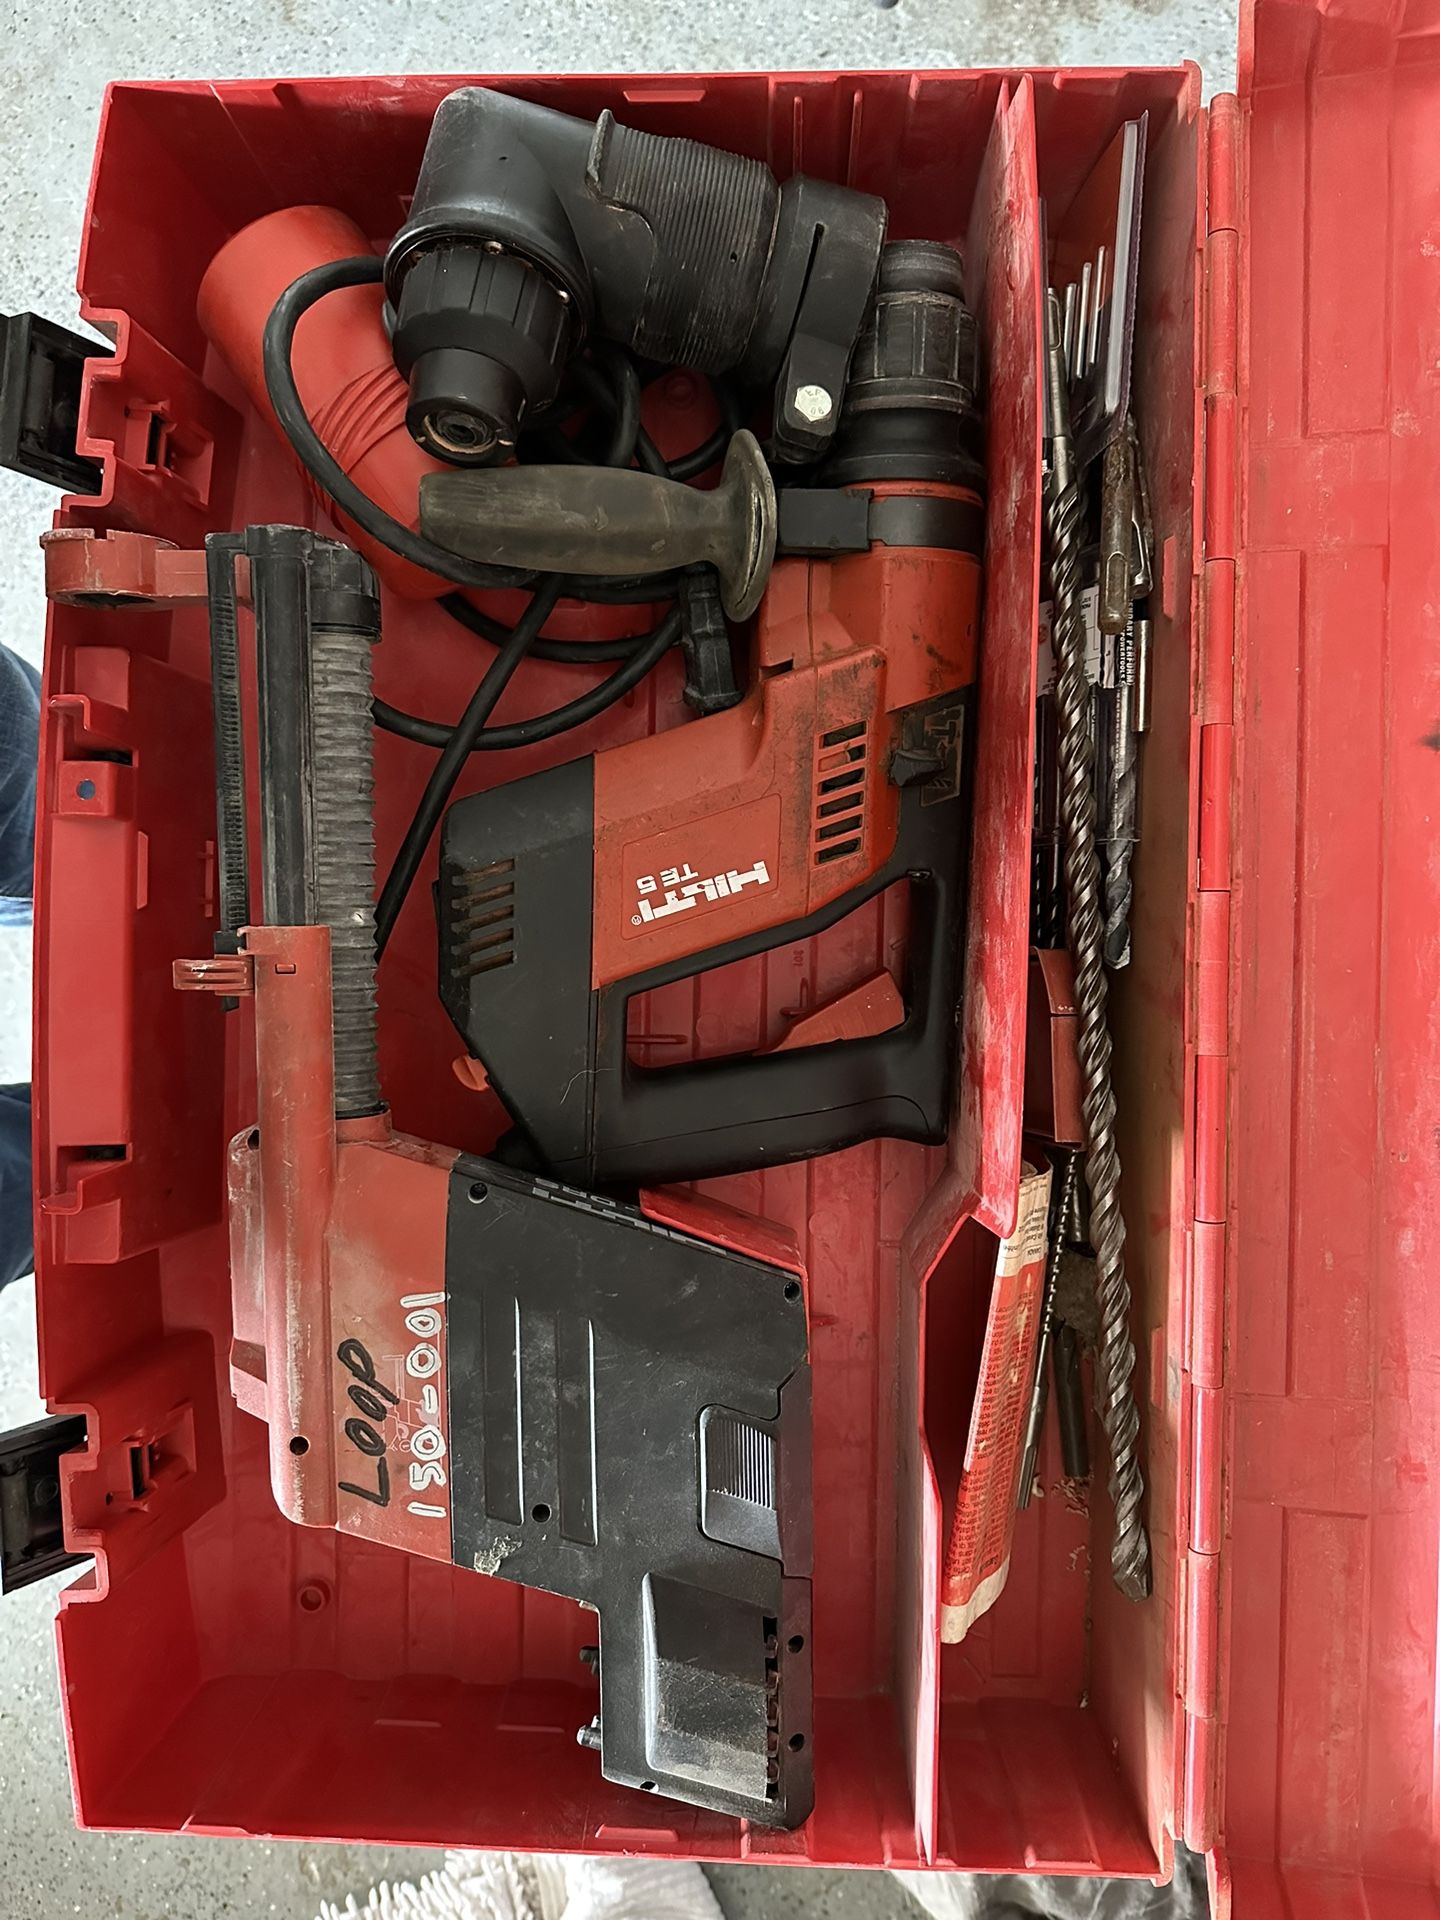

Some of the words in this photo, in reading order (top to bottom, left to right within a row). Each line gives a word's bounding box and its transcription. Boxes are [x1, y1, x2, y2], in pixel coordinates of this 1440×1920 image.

[636, 875, 658, 895] 5
[659, 863, 699, 887] TE
[336, 1338, 400, 1507] LOOP
